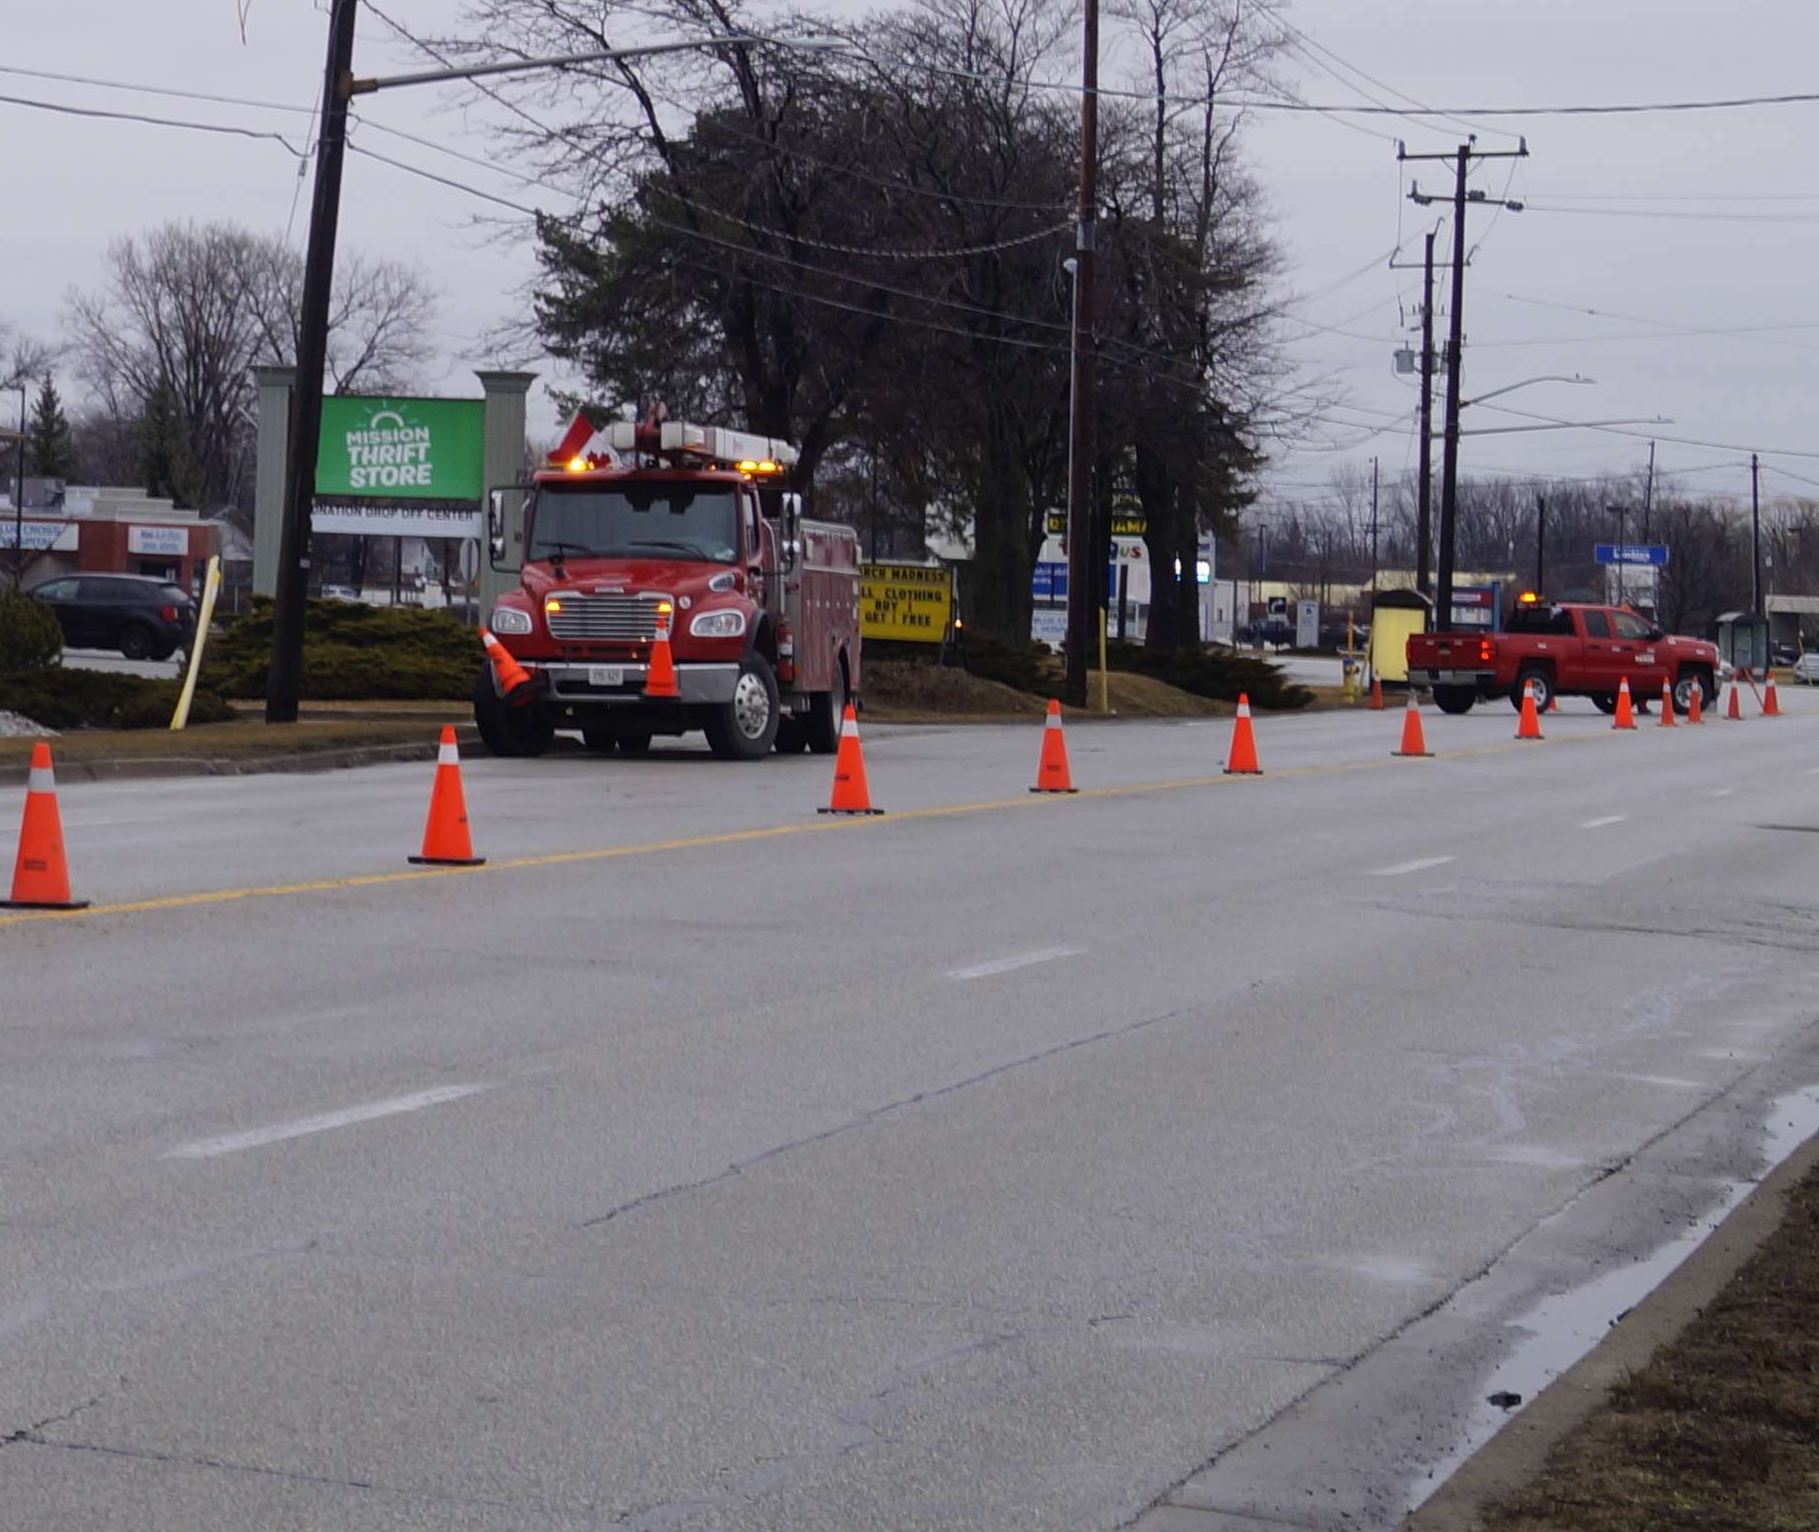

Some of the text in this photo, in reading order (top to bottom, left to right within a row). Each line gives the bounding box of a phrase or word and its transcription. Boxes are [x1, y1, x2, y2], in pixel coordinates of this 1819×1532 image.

[346, 426, 430, 446] MISSION
[347, 442, 431, 466] THRIFT
[350, 463, 433, 489] STORE
[427, 509, 474, 522] CENTER
[891, 568, 945, 583] MADNESS
[884, 587, 942, 604] CLOTHING
[875, 598, 898, 611] BUY
[865, 611, 886, 624] GET
[902, 613, 931, 627] FREE
